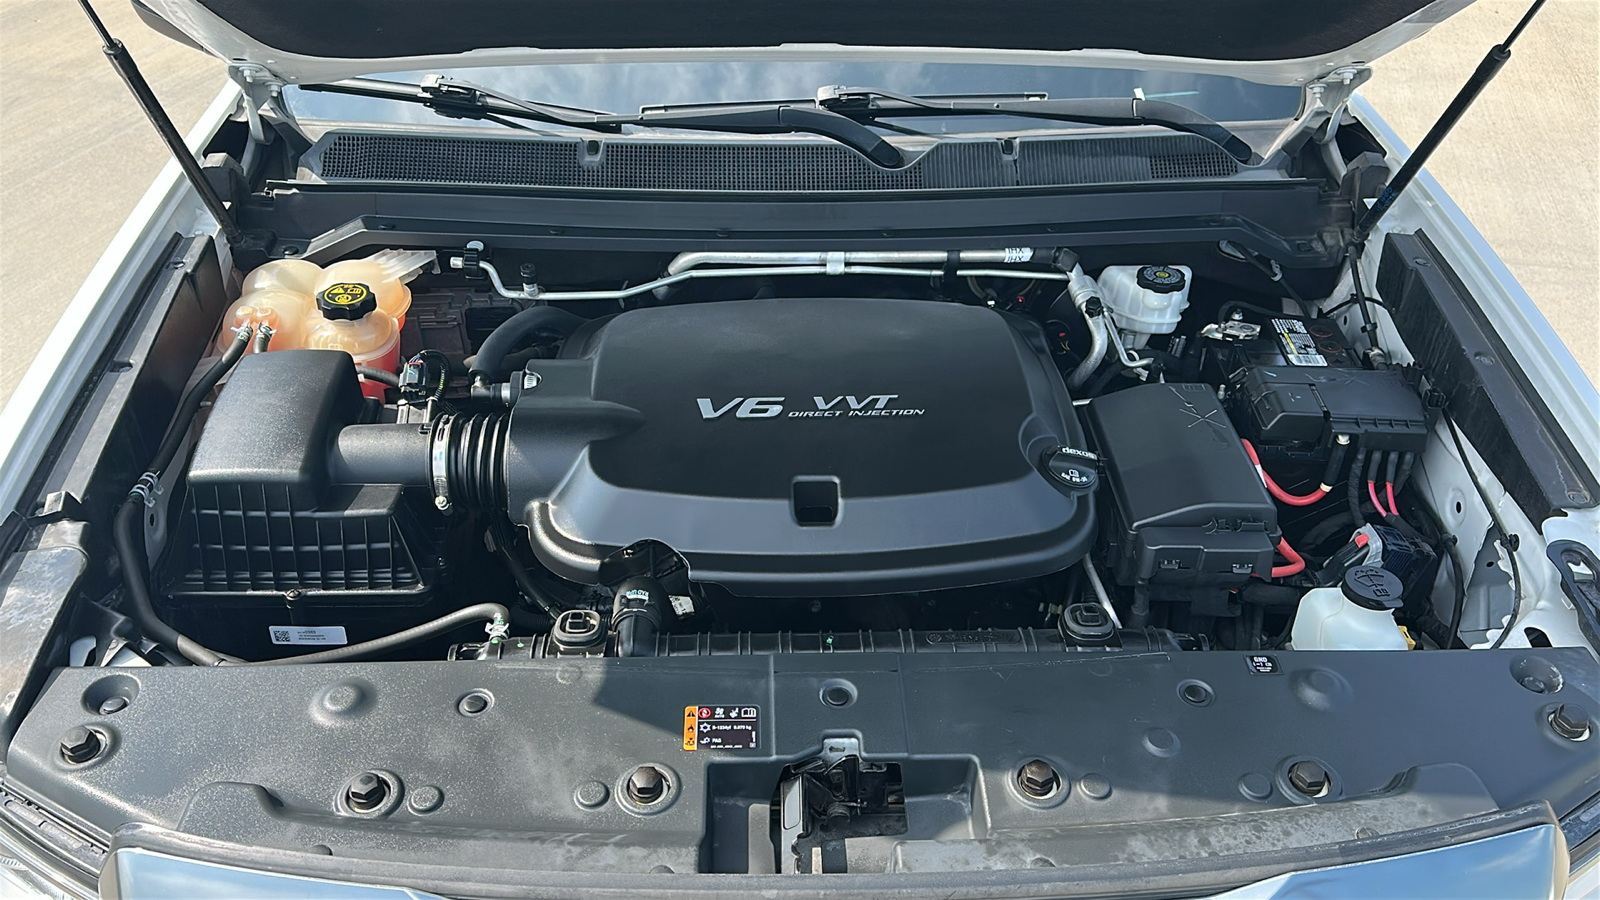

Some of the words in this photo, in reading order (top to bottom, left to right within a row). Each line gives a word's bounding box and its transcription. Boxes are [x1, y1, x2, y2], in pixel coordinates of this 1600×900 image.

[697, 397, 786, 419] V6
[813, 395, 899, 410] VVT
[788, 410, 843, 418] DIRECT
[848, 408, 925, 417] INJECTION
